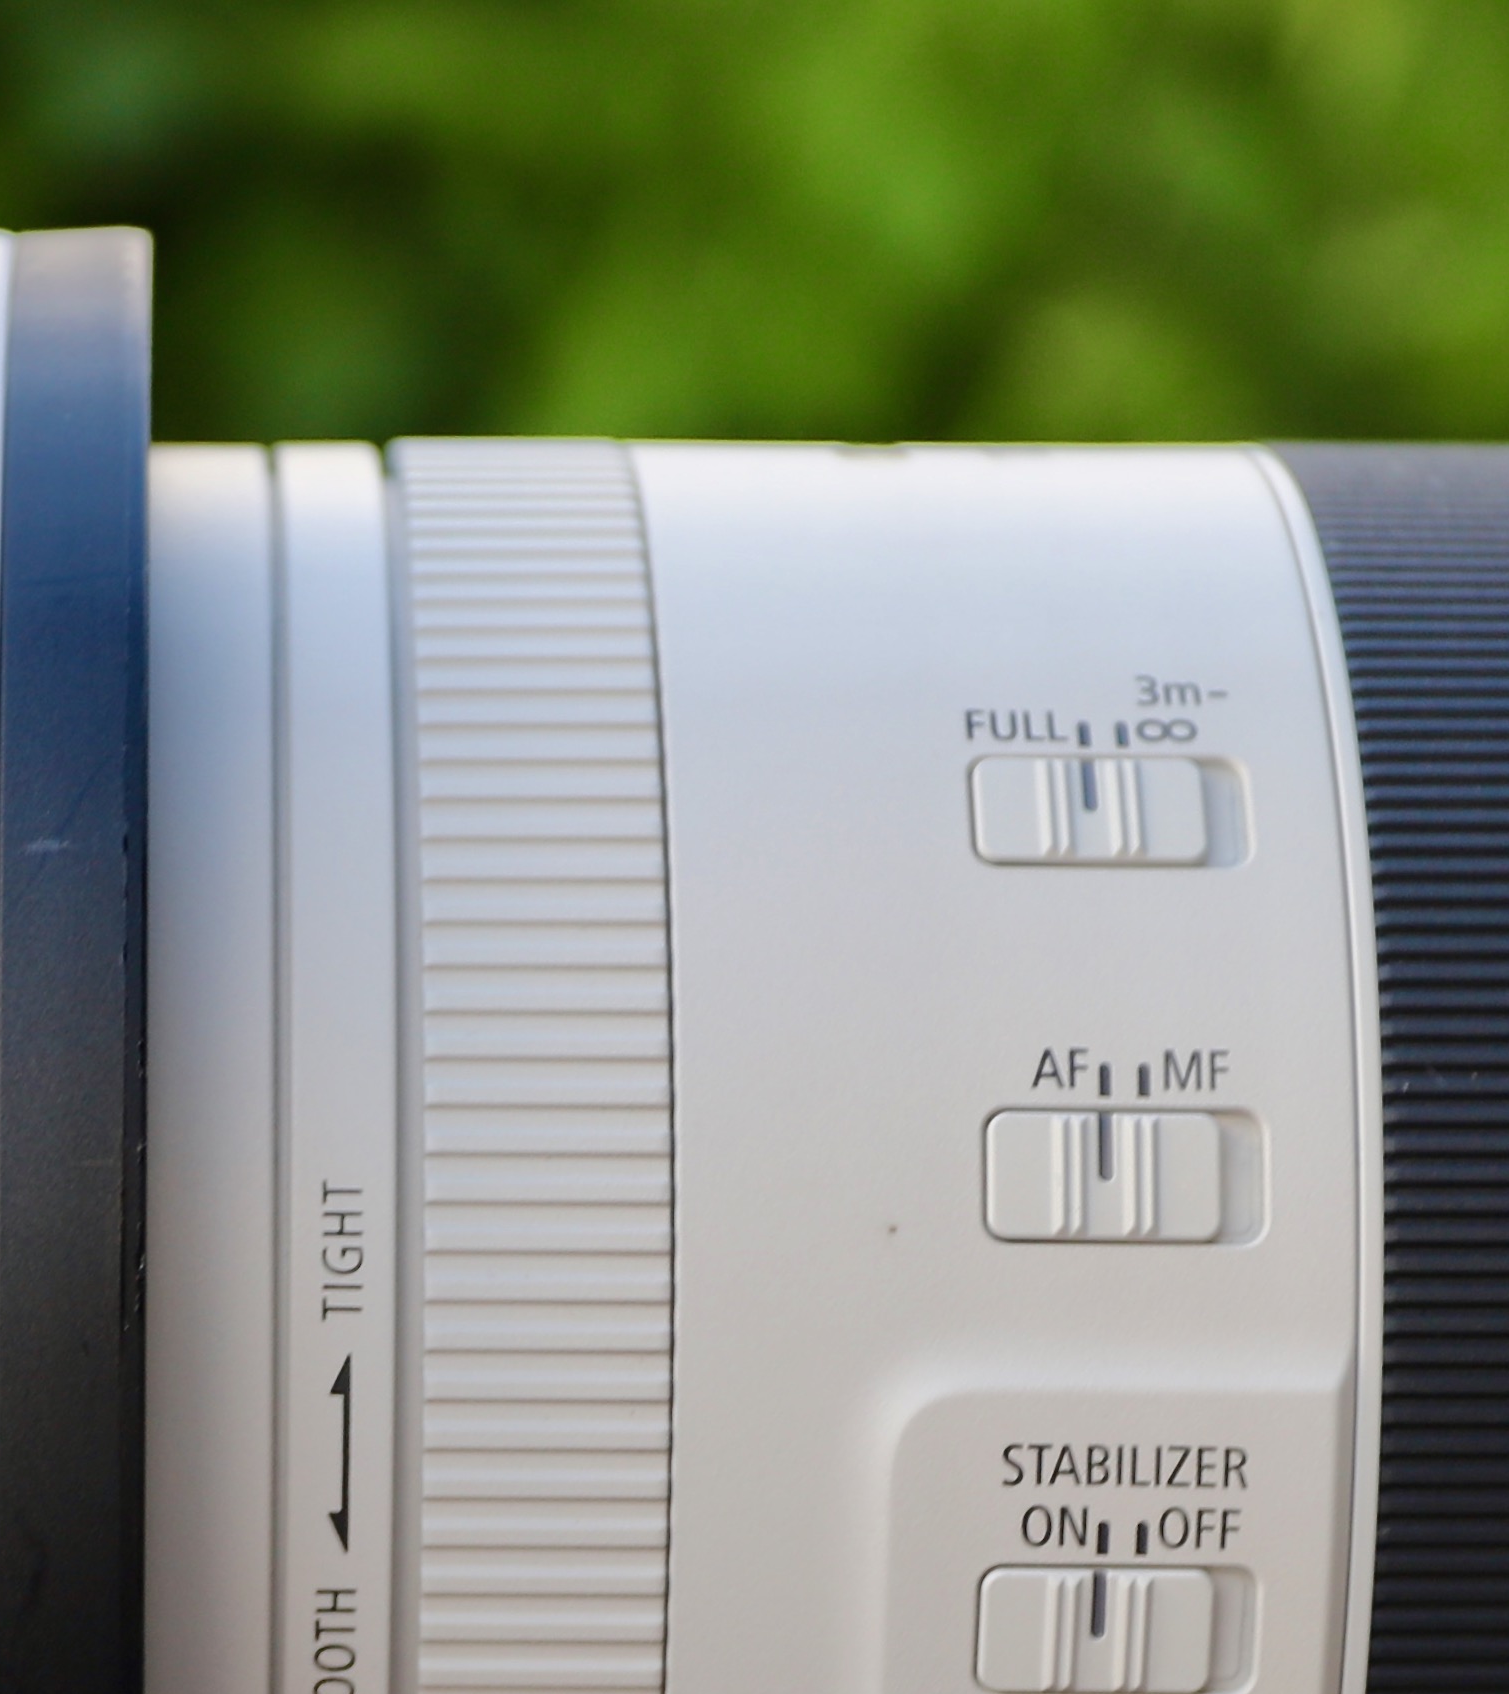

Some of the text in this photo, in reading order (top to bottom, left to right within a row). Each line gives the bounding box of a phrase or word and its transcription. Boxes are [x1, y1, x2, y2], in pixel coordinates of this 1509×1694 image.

[964, 709, 1068, 743] FULL
[1031, 1047, 1089, 1089] AF
[1163, 1049, 1230, 1091] MF
[321, 1179, 365, 1322] TIGHT
[1001, 1443, 1250, 1490] STABILIZER
[1021, 1505, 1089, 1549] ON
[1158, 1506, 1242, 1551] OFF
